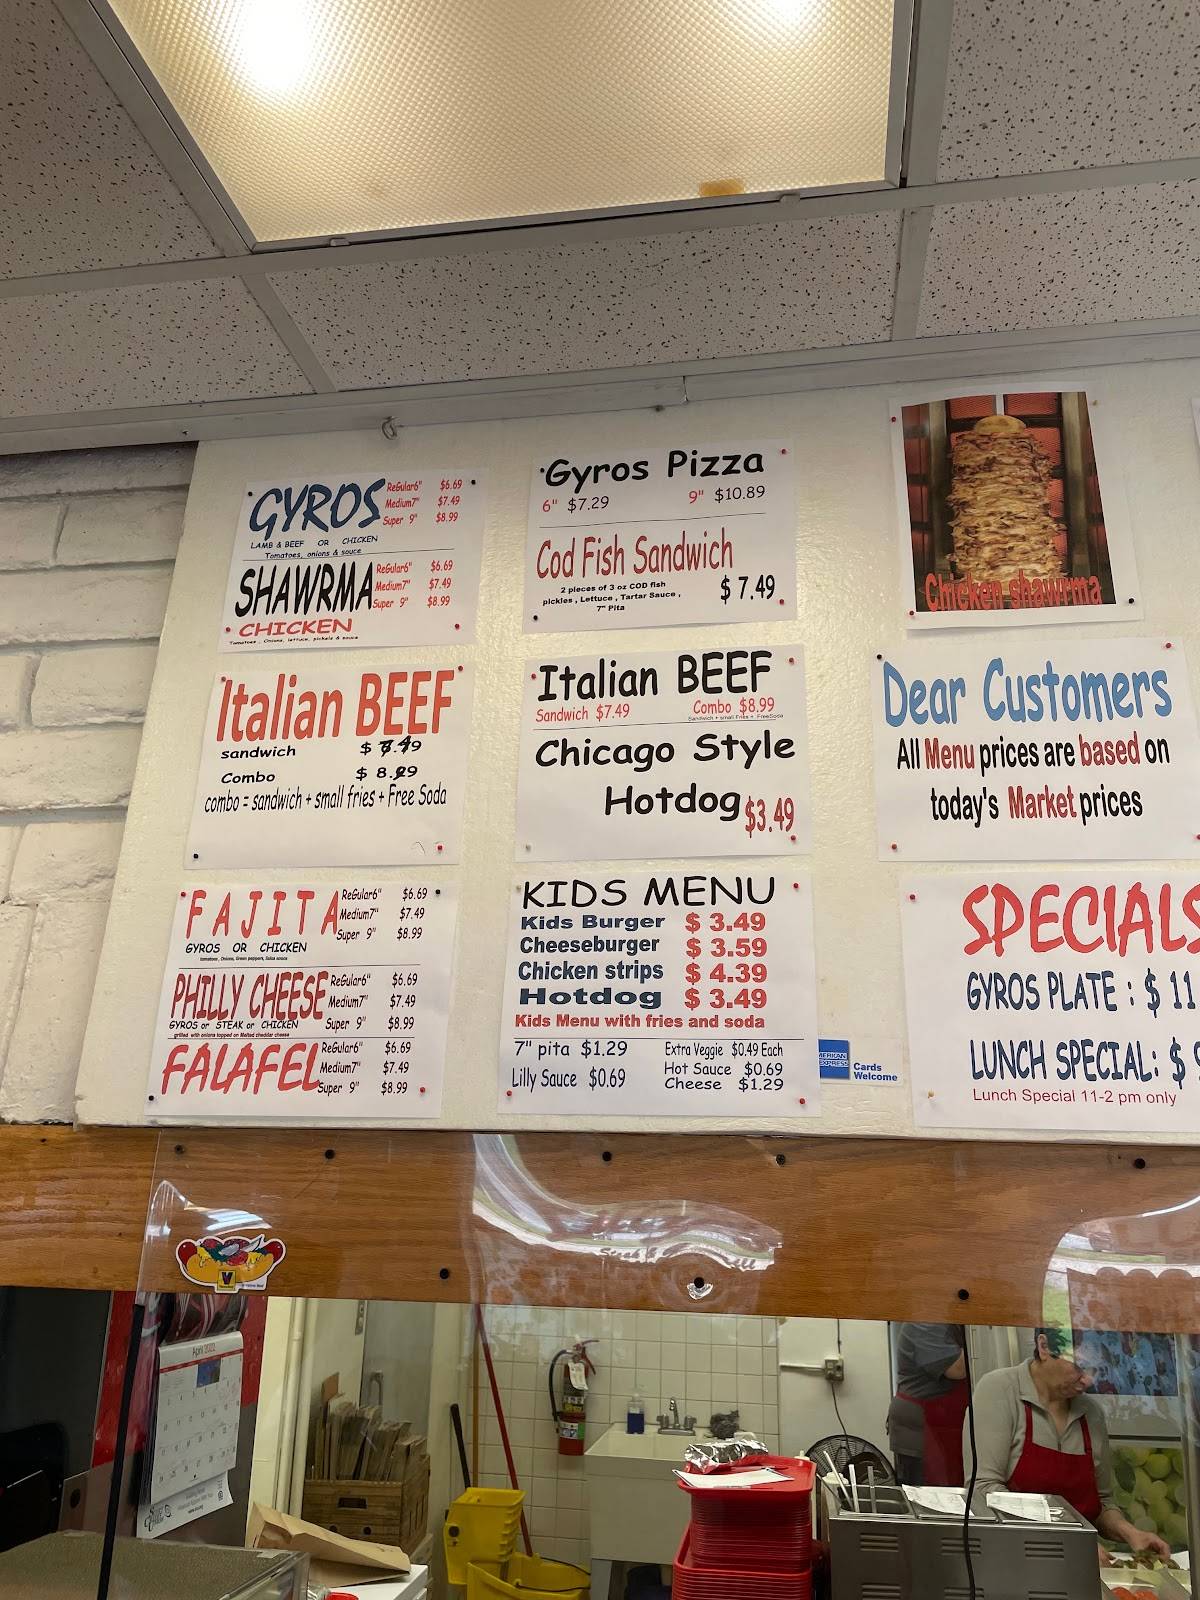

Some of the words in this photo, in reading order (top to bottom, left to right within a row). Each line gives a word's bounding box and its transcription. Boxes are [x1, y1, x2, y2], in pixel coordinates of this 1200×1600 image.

[545, 459, 649, 494] Gyros
[668, 450, 764, 478] Pizza
[440, 480, 462, 490] $6.69
[250, 478, 386, 541] GYROS
[438, 496, 460, 507] $7.49
[543, 500, 558, 512] 6"
[568, 496, 609, 514] $7.29
[689, 489, 704, 504] 9"
[715, 485, 765, 504] $10.89
[383, 516, 403, 527] Super
[436, 512, 458, 524] $8.99
[342, 536, 378, 545] CHICKEN
[536, 537, 575, 578] Cod
[582, 534, 624, 578] Fish
[633, 527, 732, 574] Sandwich
[235, 561, 373, 617] SHAWRMA
[568, 586, 596, 594] pieces
[721, 575, 731, 604] $
[739, 575, 775, 600] 7.49
[926, 572, 1002, 612] Chicken
[1009, 569, 1102, 609] shawrma
[543, 598, 572, 606] pickles
[238, 618, 352, 637] CHICKEN
[538, 658, 658, 701] Italian
[678, 650, 772, 694] BEEF
[883, 662, 965, 727] Dear
[984, 658, 1172, 723] Customers
[216, 673, 343, 742] Italian
[356, 670, 454, 736] BEEF
[536, 706, 588, 722] Sandwich
[596, 704, 630, 722] $7.49
[694, 699, 731, 714] Combo
[740, 697, 774, 715] $8.99
[220, 745, 296, 759] sandwich
[536, 738, 675, 772] Chicago
[694, 730, 795, 769] Style
[898, 738, 920, 769] All
[925, 738, 974, 769] Menu
[980, 736, 1039, 777] prices
[1044, 741, 1075, 766] are
[1079, 731, 1140, 766] based
[1145, 738, 1170, 764] on
[221, 772, 275, 784] Combo
[204, 789, 240, 812] combo
[251, 786, 302, 811] sandwich
[314, 785, 344, 809] small
[348, 784, 375, 808] fries
[388, 784, 414, 807] Free
[418, 782, 447, 805] Soda
[931, 787, 998, 828] today's
[1008, 785, 1077, 819] Market
[1080, 784, 1142, 825] prices
[605, 782, 741, 822] Hotdog
[745, 796, 794, 838] $3.49
[403, 887, 427, 900] $6.69
[523, 880, 627, 909] KIDS
[644, 876, 774, 906] MENU
[340, 908, 378, 921] Medium7"
[400, 908, 424, 920] $7.49
[521, 916, 573, 930] Kids
[582, 915, 665, 931] Burger
[685, 912, 701, 933] $
[710, 912, 766, 931] 3.49
[962, 882, 1200, 957] SPECIALS
[336, 929, 360, 943] Super
[397, 927, 422, 940] $8.99
[186, 943, 220, 953] GYROS
[232, 943, 247, 953] OR
[260, 943, 307, 953] CHICKEN
[520, 936, 659, 956] Cheeseburger
[686, 938, 701, 958] $
[710, 938, 767, 957] 3.59
[392, 973, 417, 986] $6.69
[518, 961, 598, 980] Chicken
[605, 961, 664, 983] strips
[686, 962, 700, 984] $
[710, 963, 767, 982] 4.39
[171, 973, 244, 1020] PHILLY
[250, 970, 328, 1020] CHEESE
[328, 995, 368, 1009] Medium7"
[390, 994, 416, 1008] $7.49
[520, 988, 661, 1009] Hotdog
[684, 988, 700, 1010] $
[710, 988, 767, 1008] 3.49
[967, 971, 1040, 1011] GYROS
[1048, 970, 1118, 1012] PLATE
[1145, 968, 1160, 1018] $
[1170, 971, 1195, 1009] 11
[169, 1021, 198, 1029] GYROS
[216, 1021, 243, 1029] STEAK
[261, 1020, 298, 1029] CHICKEN
[326, 1017, 349, 1031] Super
[388, 1017, 414, 1030] $8.99
[516, 1014, 550, 1027] Kids
[556, 1015, 600, 1028] Menu
[605, 1014, 640, 1027] with
[646, 1014, 683, 1027] fries
[689, 1015, 719, 1028] and
[724, 1015, 764, 1028] soda
[514, 1041, 532, 1056] 7"
[538, 1041, 570, 1060] pita
[580, 1041, 628, 1058] $1.29
[665, 1042, 690, 1057] Extra
[694, 1042, 723, 1060] Veggie
[732, 1042, 758, 1058] $0.49
[762, 1042, 783, 1056] Each
[162, 1042, 320, 1094] FALAFEL
[664, 1062, 688, 1075] Hot
[694, 1063, 732, 1075] Sauce
[744, 1062, 783, 1077] $0.69
[854, 1063, 882, 1071] Cards
[970, 1039, 1047, 1080] LUNCH
[1056, 1039, 1158, 1082] SPECIAL:
[1170, 1036, 1185, 1090] $
[512, 1068, 537, 1092] Lilly
[541, 1069, 577, 1088] Sauce
[589, 1068, 626, 1090] $0.69
[665, 1078, 722, 1090] Cheese
[739, 1078, 783, 1091] $1.29
[854, 1072, 897, 1081] Welcome
[973, 1088, 1017, 1102] Lunch
[1022, 1089, 1075, 1104] Special
[1081, 1090, 1113, 1102] 11-2
[1119, 1093, 1141, 1106] pm
[1147, 1091, 1176, 1106] only
